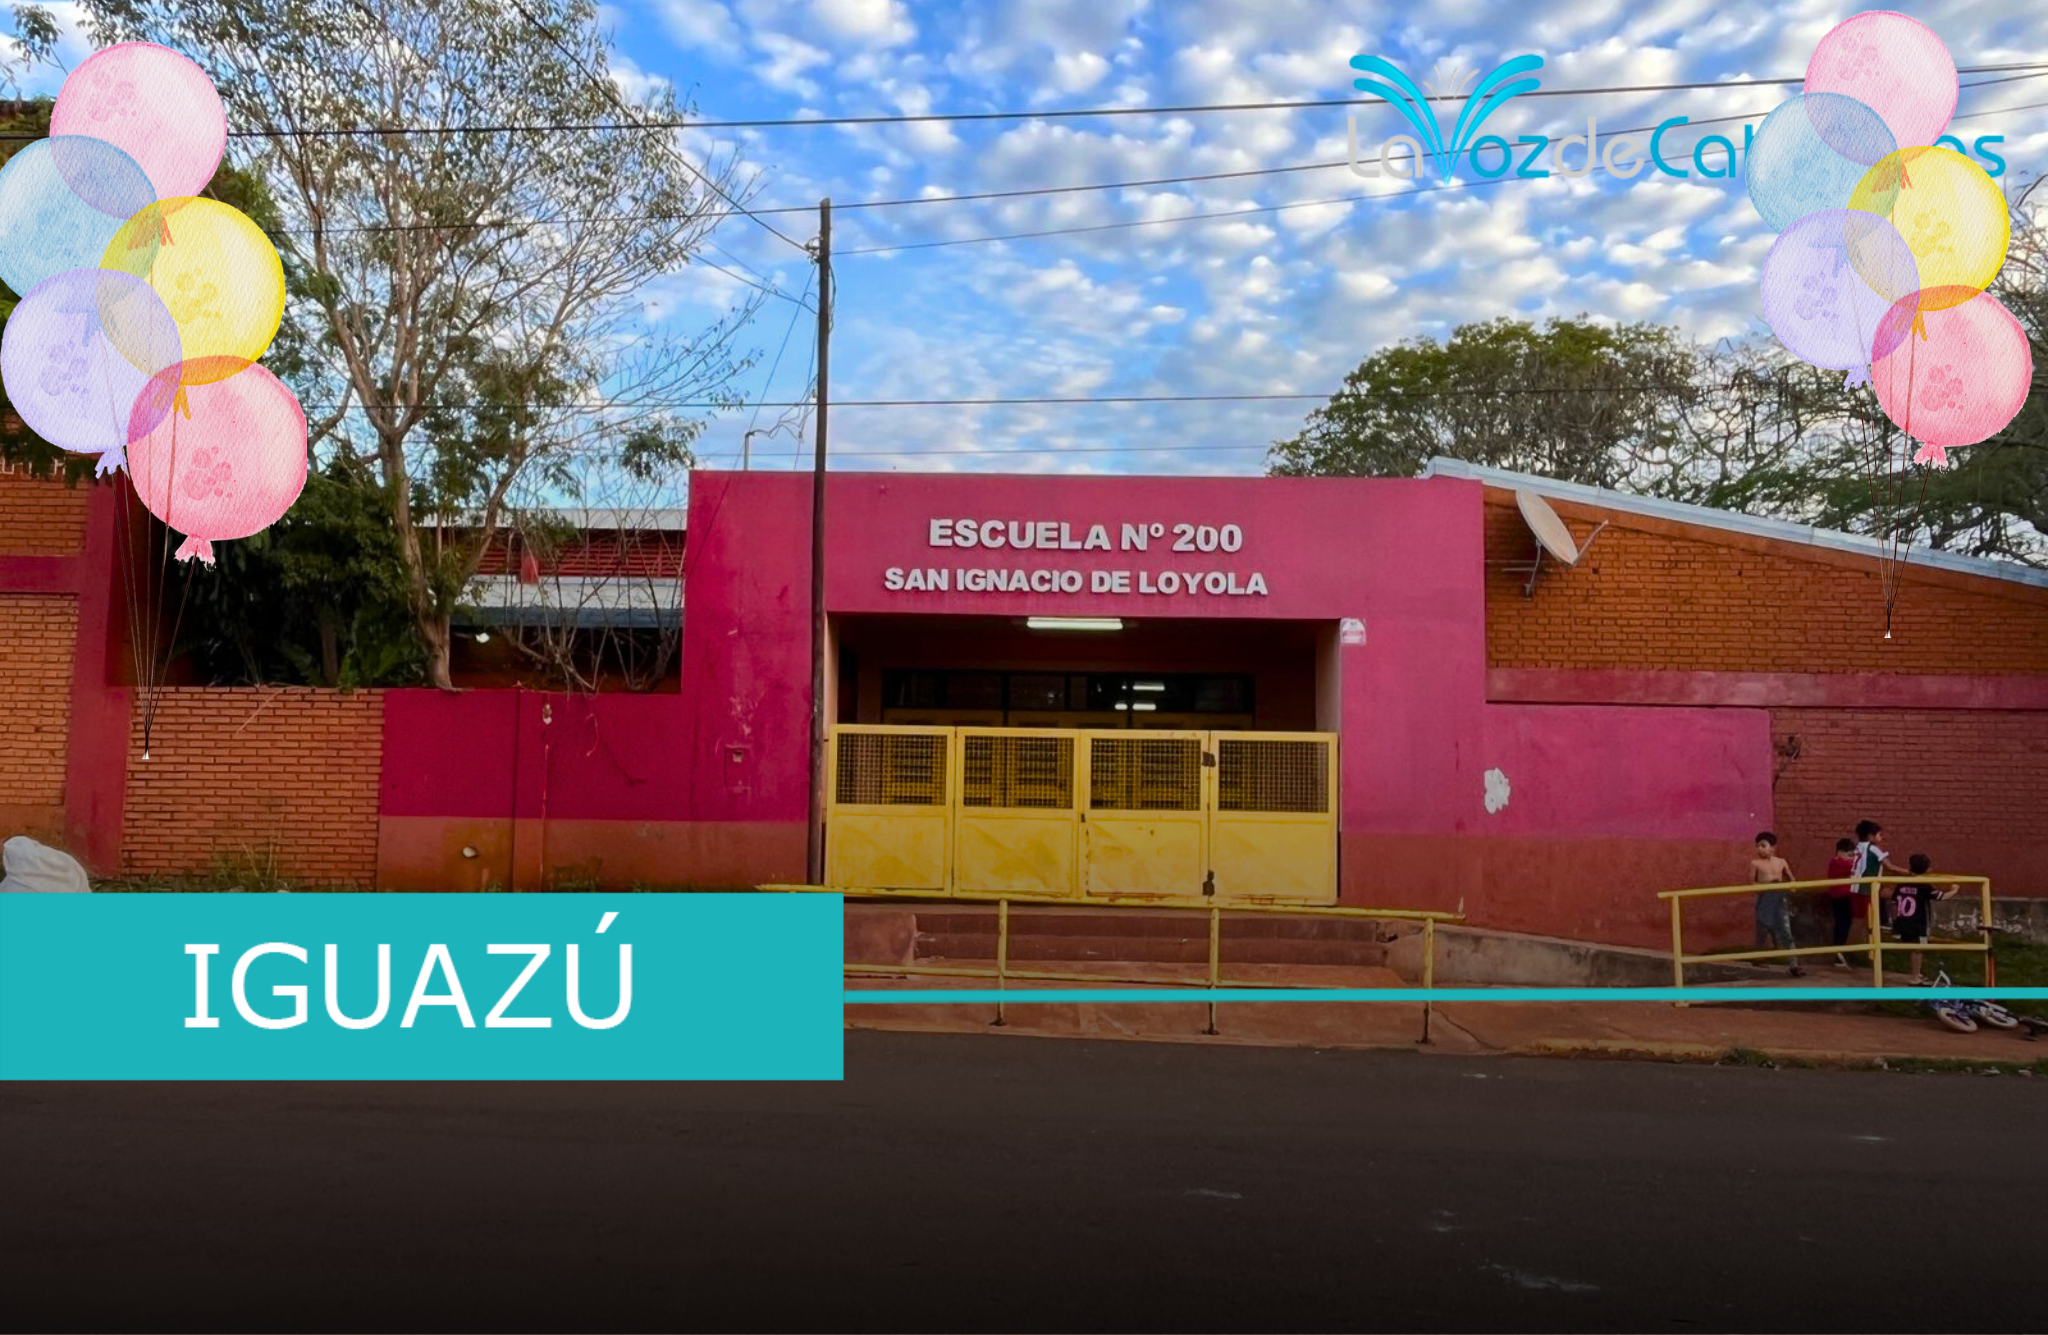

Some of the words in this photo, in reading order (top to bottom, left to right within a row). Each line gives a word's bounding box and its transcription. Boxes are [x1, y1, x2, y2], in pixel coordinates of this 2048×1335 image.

[928, 517, 1113, 552] ESCUELA
[1172, 522, 1243, 553] 200
[883, 566, 949, 593] SAN
[956, 567, 1083, 594] IGNACIO
[1091, 569, 1132, 594] DE
[1139, 570, 1270, 596] LOYOLA
[1896, 895, 1917, 917] 10
